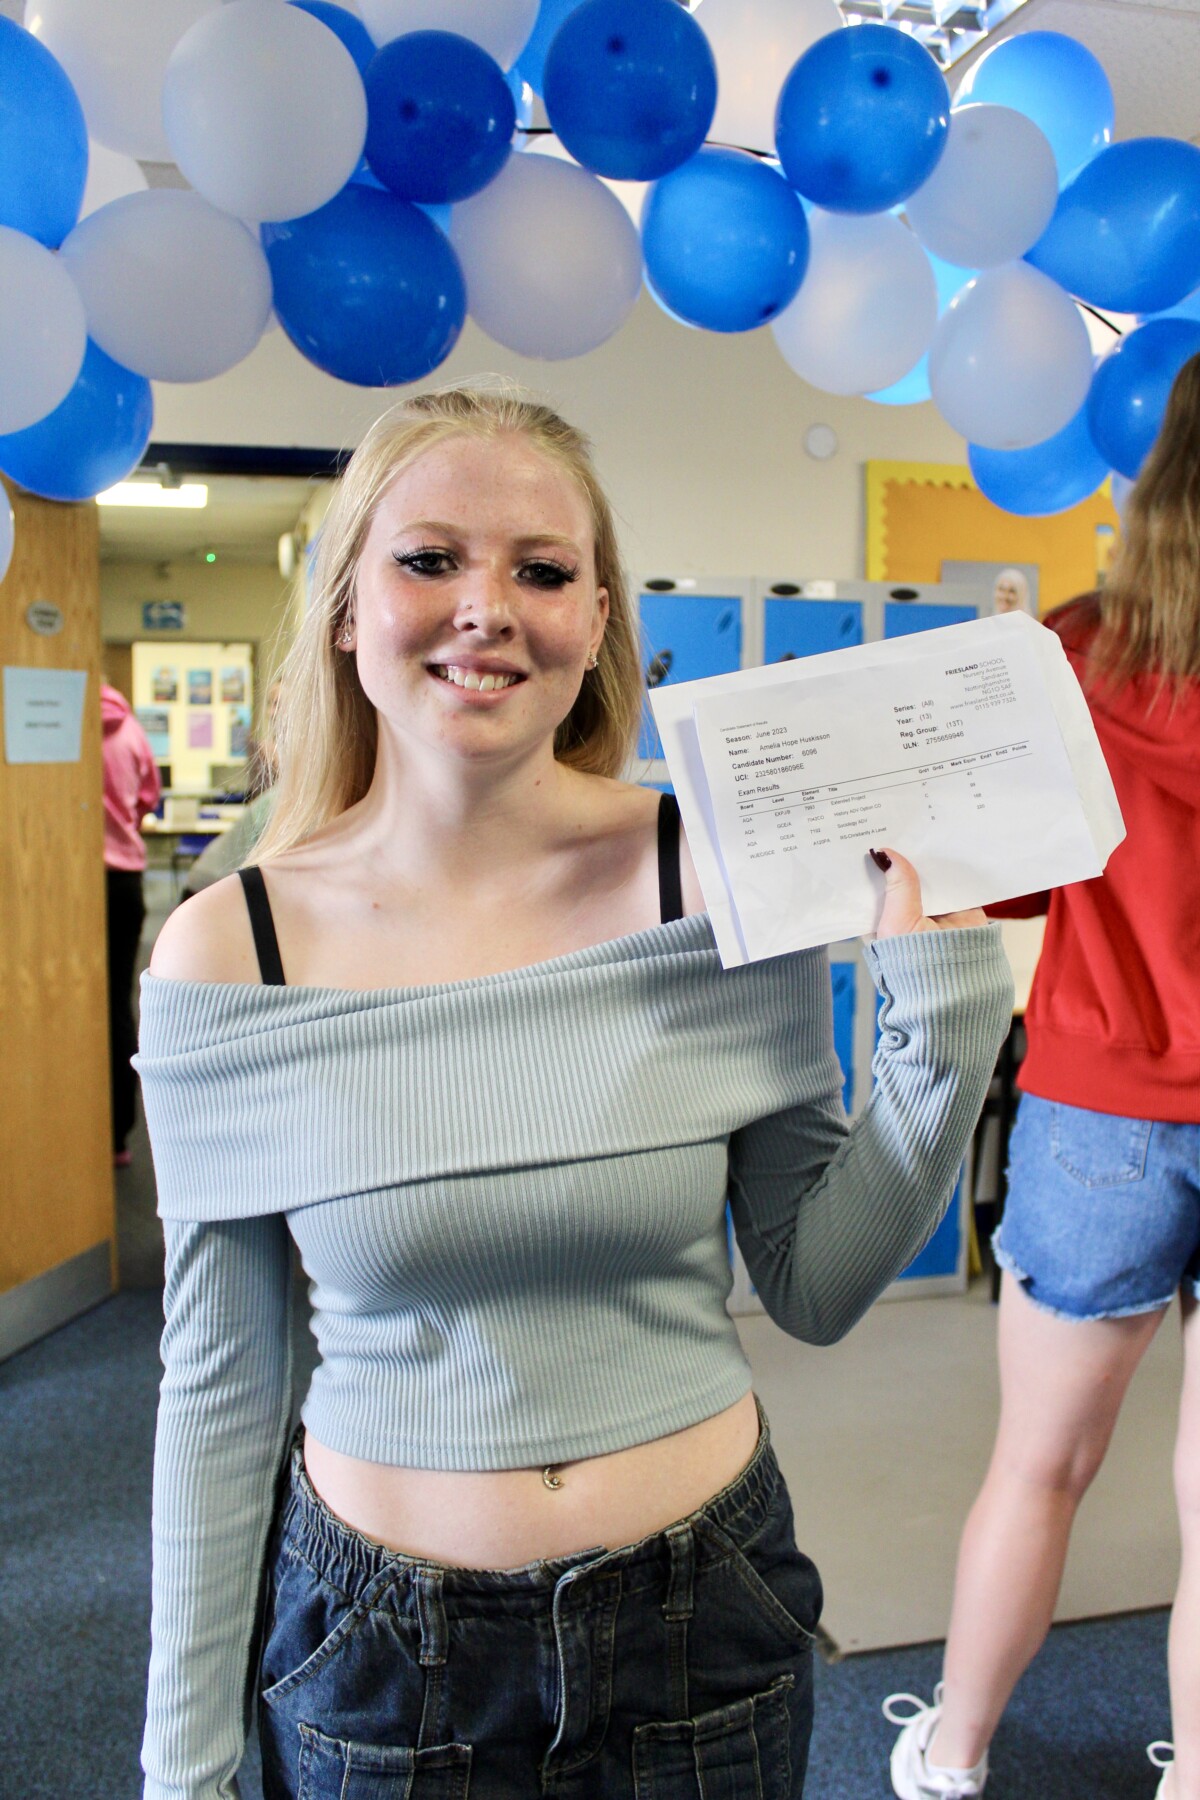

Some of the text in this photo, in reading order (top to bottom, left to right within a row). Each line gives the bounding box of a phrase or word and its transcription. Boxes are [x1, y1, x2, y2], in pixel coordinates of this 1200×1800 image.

[945, 658, 1004, 675] FRIESLAND SCHOOL
[963, 670, 985, 679] Nursery
[981, 671, 1008, 681] Sandiacre
[965, 678, 1010, 692] Nottinghamshire
[894, 704, 916, 713] Series:
[975, 703, 989, 711] 0115
[726, 735, 752, 743] Season:
[772, 727, 787, 735] 2023
[900, 720, 963, 739] Reg. Group: (13T)
[729, 733, 830, 756] Name: Amelia Hope Huskisson
[732, 759, 764, 769] Candidate
[766, 754, 794, 763] Number:
[757, 784, 780, 793] Results
[831, 797, 850, 805] Extended
[851, 794, 866, 803] Project
[837, 820, 857, 829] Sociology
